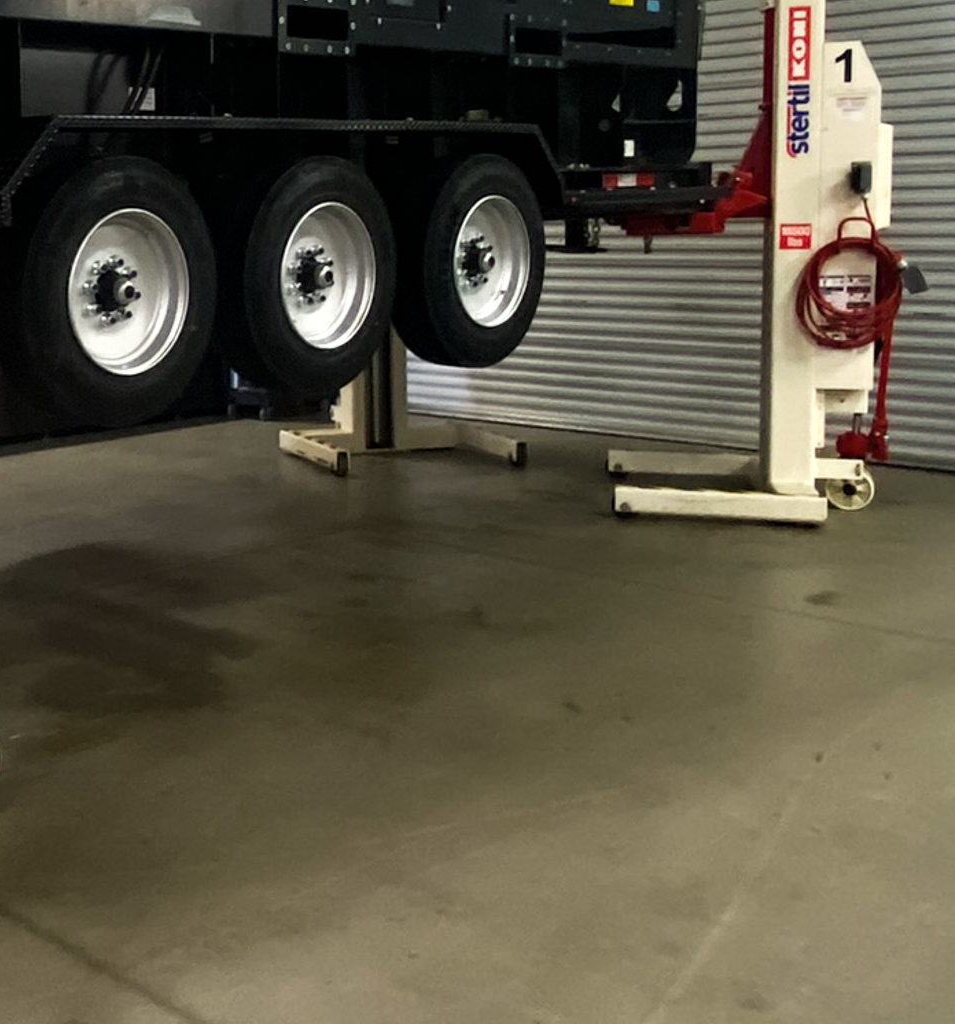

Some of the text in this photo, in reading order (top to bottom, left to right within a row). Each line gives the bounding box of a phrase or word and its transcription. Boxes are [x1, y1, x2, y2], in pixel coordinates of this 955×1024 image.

[786, 10, 810, 156] stertil KONI
[835, 48, 853, 83] 1
